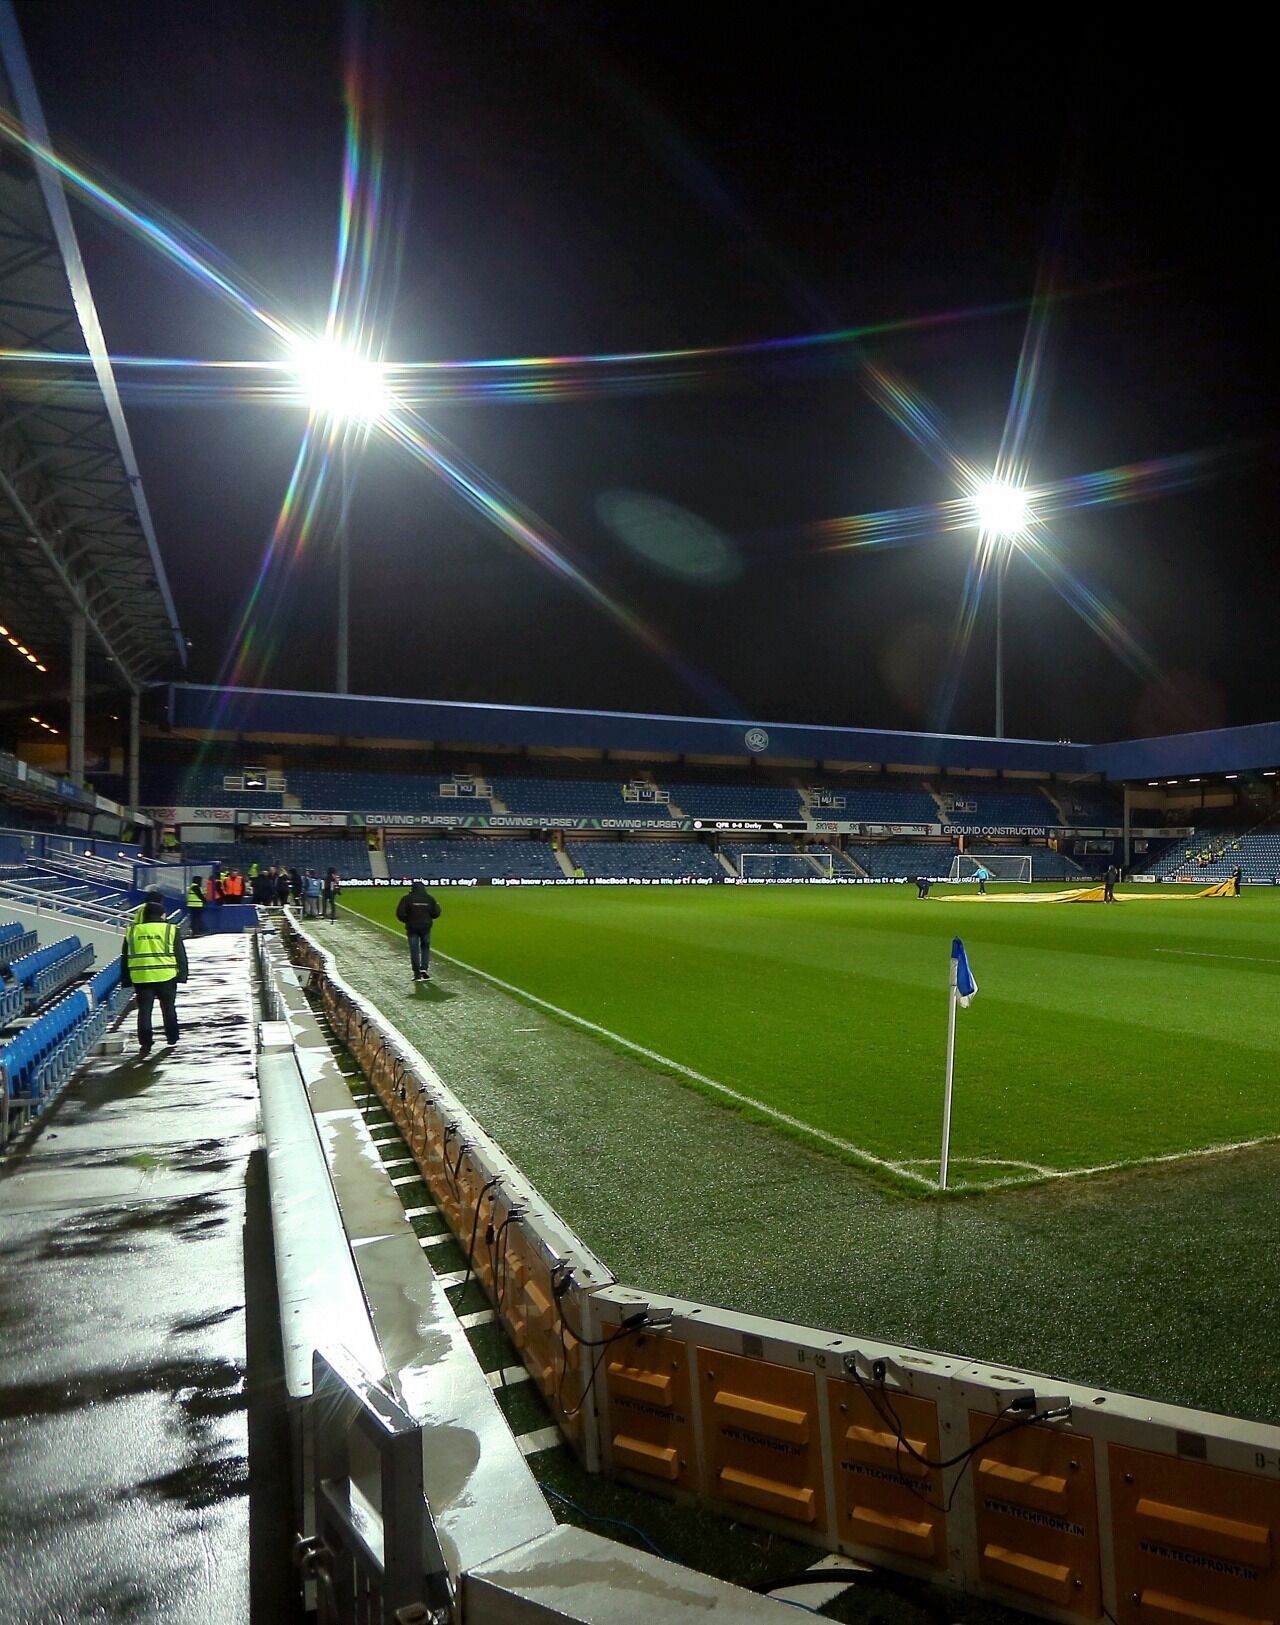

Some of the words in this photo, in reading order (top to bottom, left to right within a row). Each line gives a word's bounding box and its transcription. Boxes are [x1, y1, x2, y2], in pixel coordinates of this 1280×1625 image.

[366, 815, 415, 825] GOWING
[421, 816, 464, 825] PURSEY
[489, 817, 533, 826] GOWING
[539, 818, 578, 827] PURSEY
[601, 818, 642, 828] GOWING
[647, 819, 683, 829] PURSEY
[745, 822, 762, 831] Derby
[943, 825, 982, 835] GROUND
[982, 826, 1045, 836] CONSTRUCTION
[375, 878, 389, 886] Pro
[390, 878, 402, 886] for
[458, 878, 478, 887] day?
[595, 877, 628, 885] MacBook
[697, 878, 713, 886] day?
[983, 1498, 1086, 1538] WWW.TECHFRONT.IN
[1138, 1541, 1258, 1580] WWW.TECHFRONT.IN
